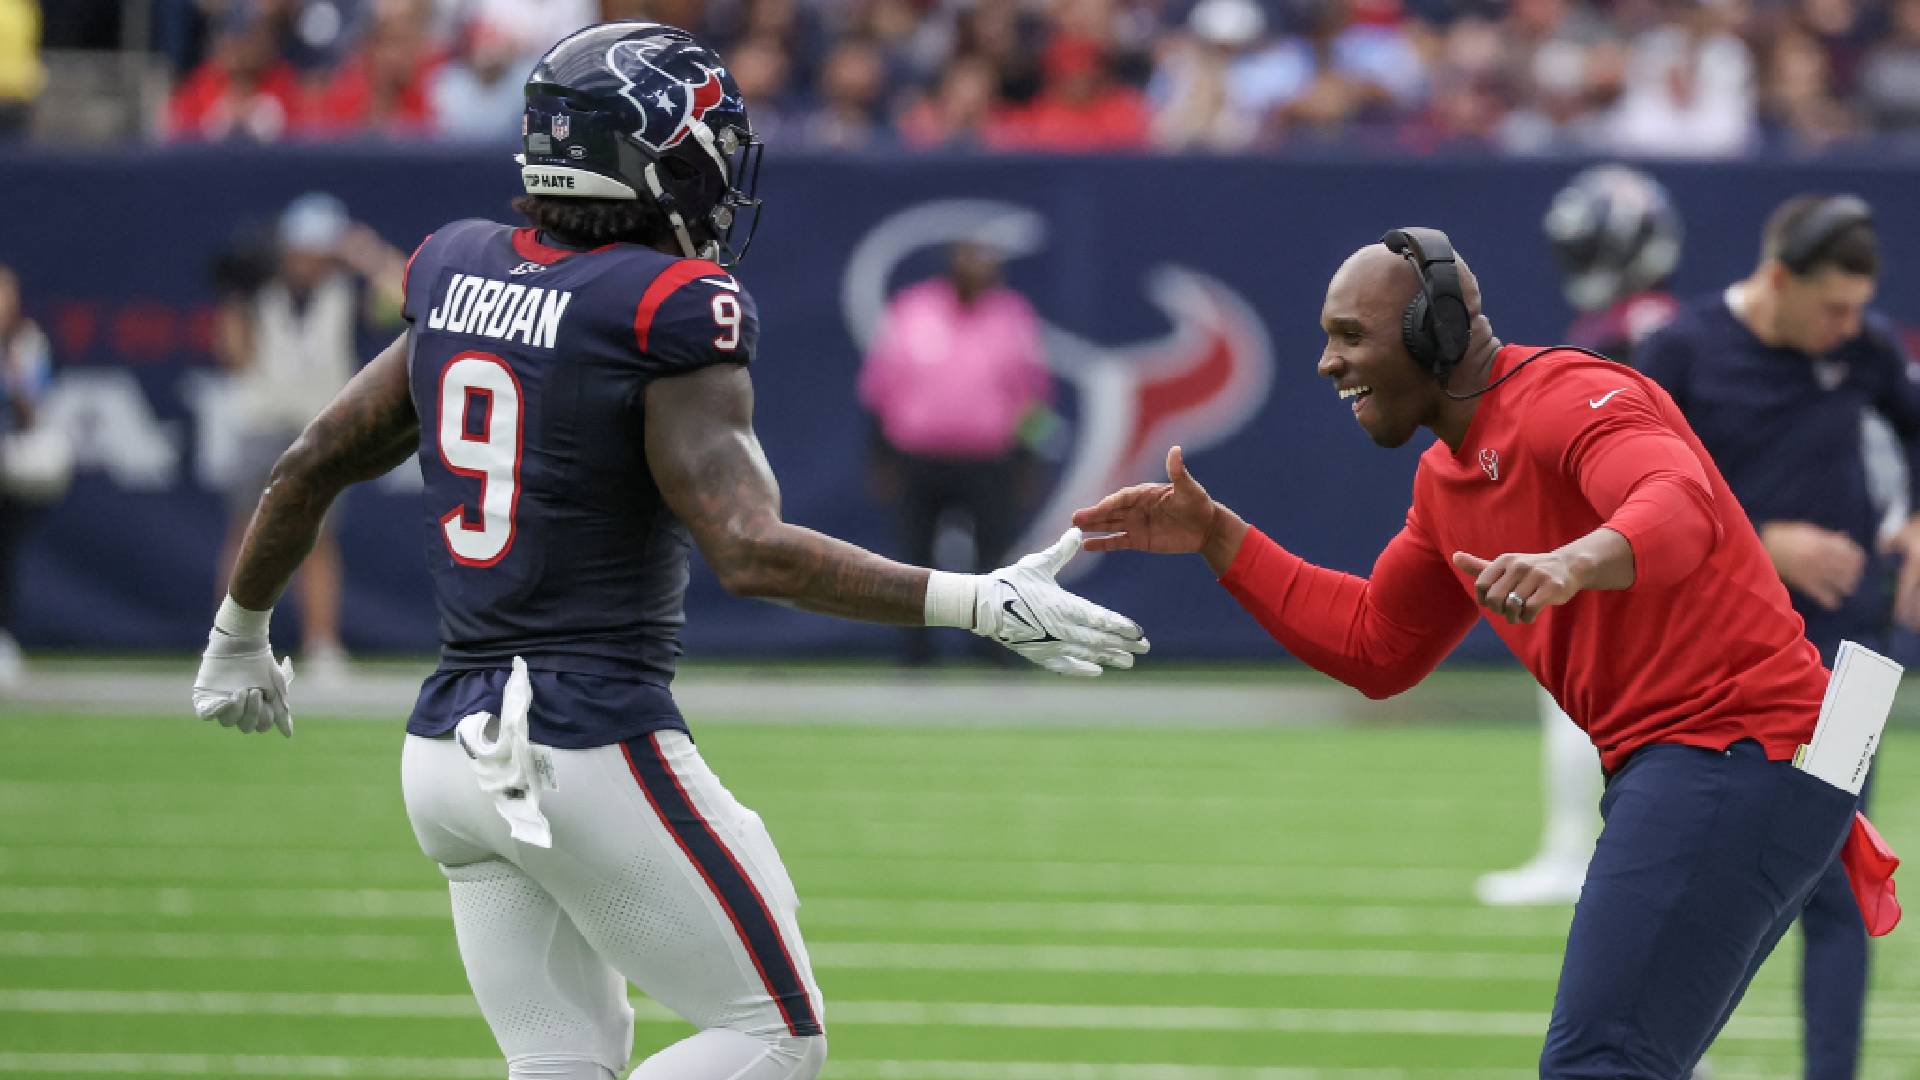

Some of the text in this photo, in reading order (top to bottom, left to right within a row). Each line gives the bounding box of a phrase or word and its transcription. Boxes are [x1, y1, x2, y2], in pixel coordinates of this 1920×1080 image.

[541, 174, 575, 189] HATE
[428, 274, 571, 349] JORDAN
[713, 293, 742, 350] 9
[439, 351, 524, 567] 9
